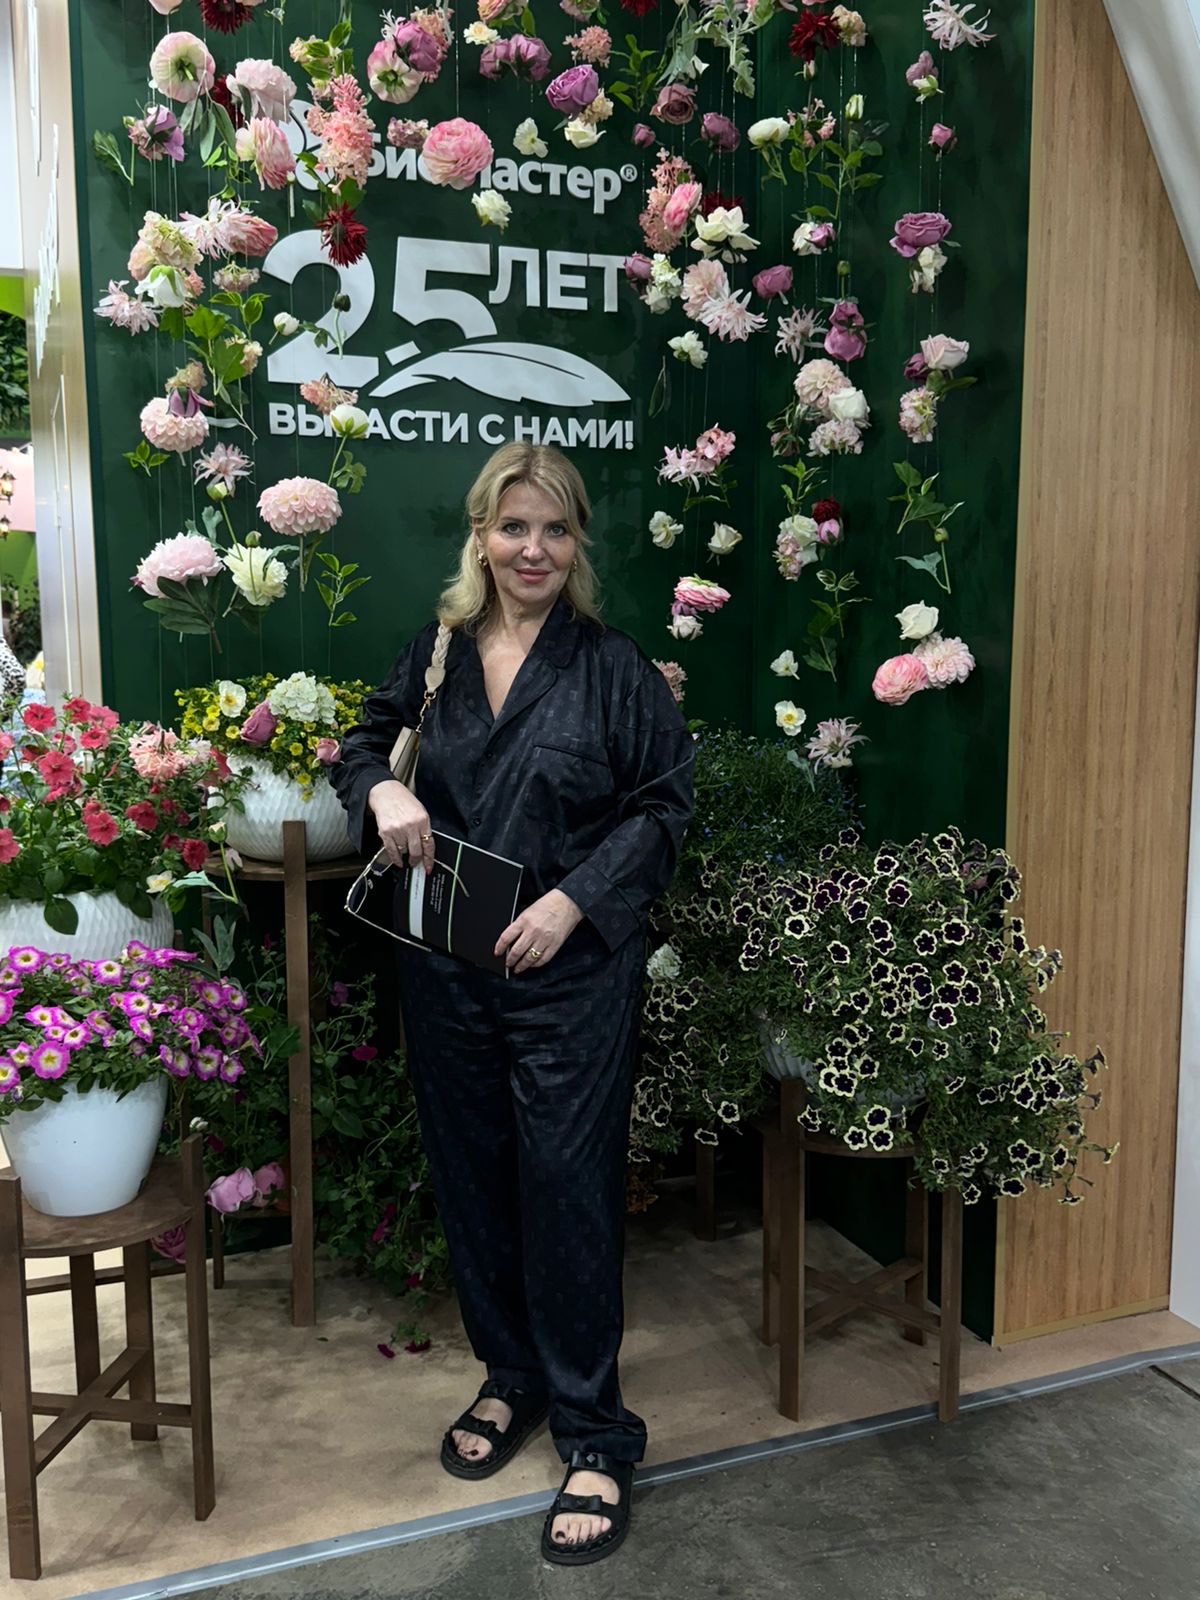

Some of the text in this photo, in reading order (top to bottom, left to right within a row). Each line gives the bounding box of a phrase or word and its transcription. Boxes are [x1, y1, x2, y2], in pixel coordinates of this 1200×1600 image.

[263, 229, 625, 388] 25 ЛЕТ
[268, 402, 634, 450] ВЫАСТИ С НАМИ!
